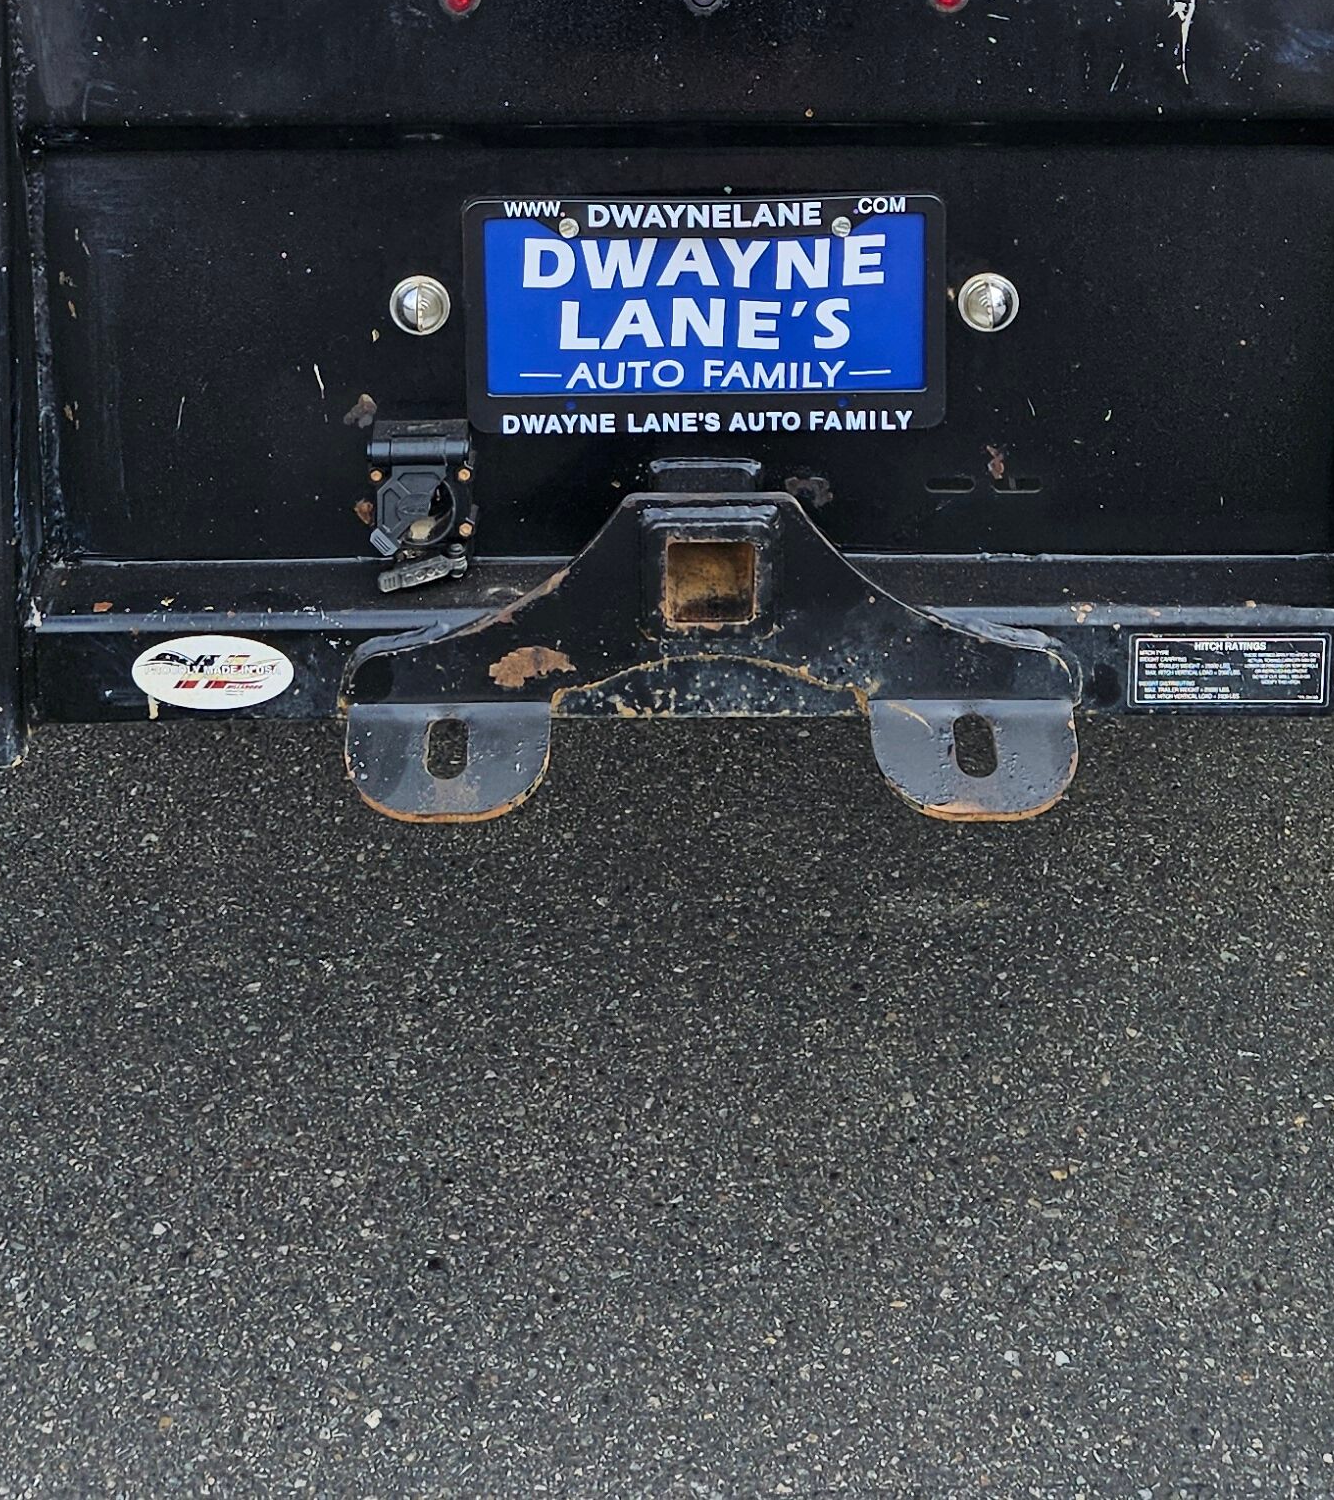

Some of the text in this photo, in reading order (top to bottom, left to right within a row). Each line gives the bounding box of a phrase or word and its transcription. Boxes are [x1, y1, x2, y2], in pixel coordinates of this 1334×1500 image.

[504, 196, 906, 229] WWW. DWAYNELANE .COM
[522, 234, 886, 290] DWAYNE
[559, 297, 850, 350] LANE'S
[565, 360, 846, 389] AUTO FAMILY
[502, 410, 913, 434] DWAYNE LANE'S AUTO FAMILY
[1193, 641, 1267, 651] HITCH RATINGS
[203, 665, 240, 676] MADE
